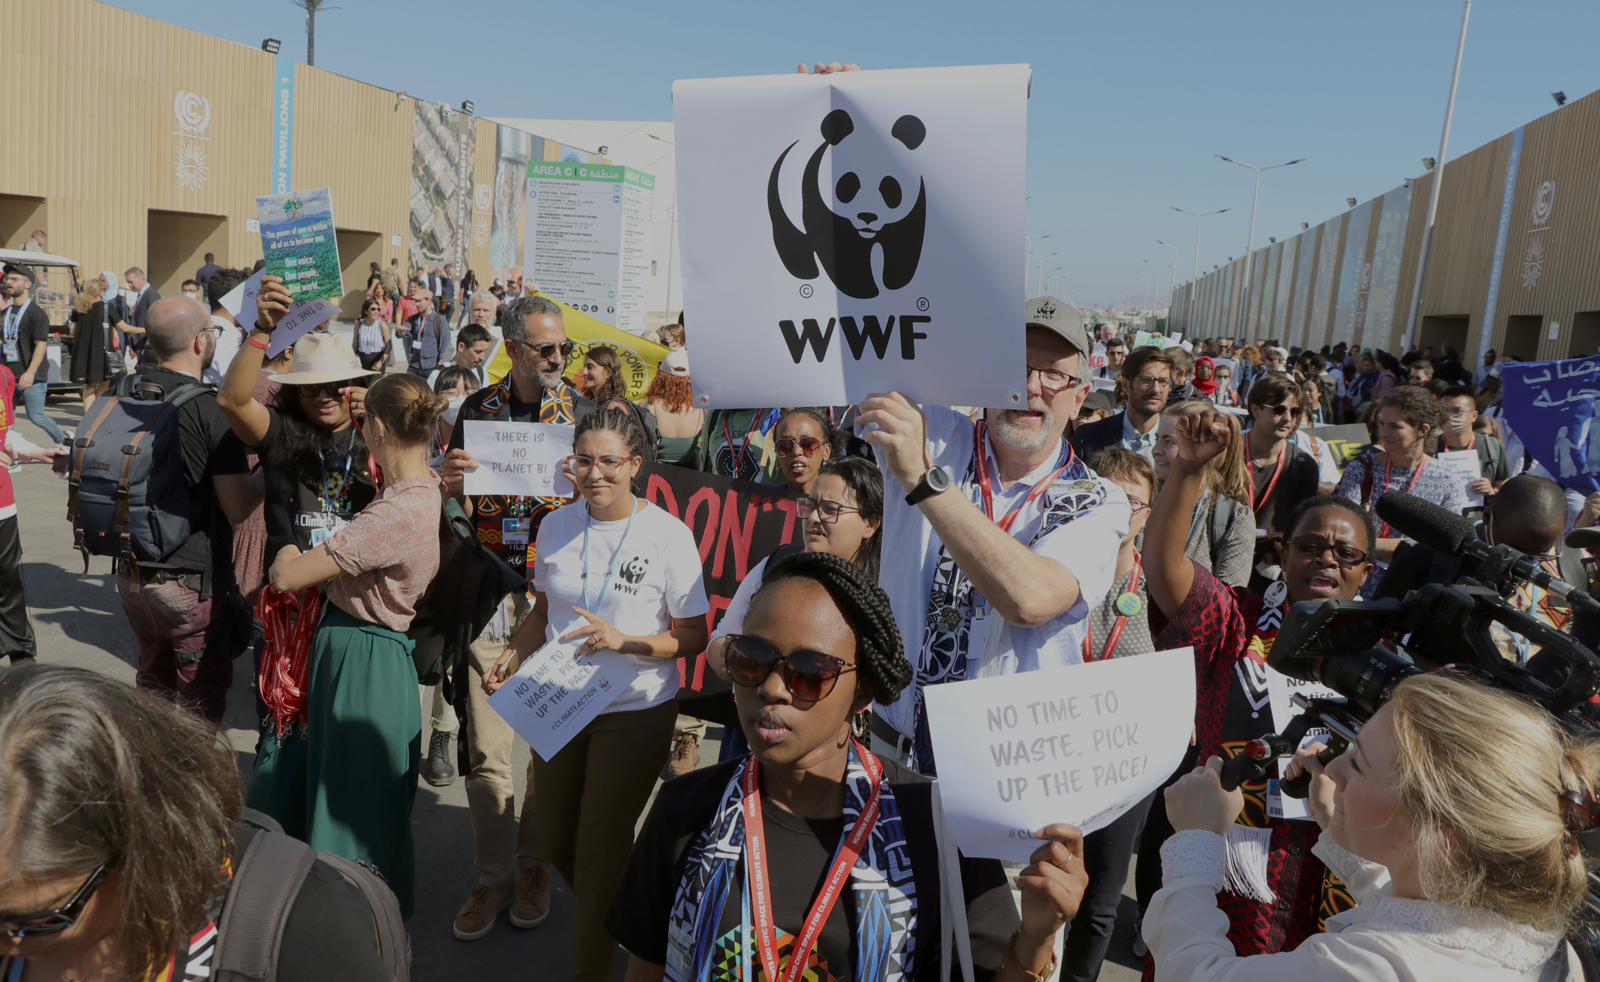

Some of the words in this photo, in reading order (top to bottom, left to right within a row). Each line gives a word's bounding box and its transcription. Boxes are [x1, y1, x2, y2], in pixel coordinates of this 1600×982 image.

[279, 88, 289, 168] PAVILIONS
[532, 165, 562, 176] AREA
[564, 167, 572, 176] C
[579, 168, 587, 177] C
[590, 169, 619, 179] منطقة
[626, 170, 636, 181] AREA
[458, 134, 466, 226] SETTLEMENTS
[1496, 164, 1516, 255] PAVILIONS
[276, 229, 291, 238] power
[455, 228, 464, 276] HUMAN
[285, 258, 297, 267] One
[298, 256, 315, 266] voice,
[285, 272, 297, 280] One
[298, 269, 319, 279] people,
[289, 285, 301, 293] One
[302, 281, 320, 291] world.
[297, 306, 316, 322] TIME
[314, 302, 326, 311] NO
[286, 322, 298, 331] TO
[779, 315, 931, 364] WWF
[495, 432, 529, 442] THERE
[534, 432, 544, 443] IS
[512, 447, 526, 458] NO
[492, 462, 532, 474] PLANET
[537, 463, 547, 474] B!
[300, 514, 334, 527] Climae
[615, 582, 641, 596] WWF
[1369, 657, 1387, 670] 18-80
[514, 682, 529, 698] NO
[528, 662, 550, 685] TIME
[550, 650, 564, 663] TO
[524, 676, 561, 709] WASTE,
[559, 657, 581, 676] PICK
[535, 704, 549, 719] UP
[549, 686, 569, 706] THE
[569, 662, 593, 688] PACE!
[551, 686, 598, 731] #CLIMATEACTION
[986, 704, 1018, 732] NO
[1026, 696, 1081, 725] TIME
[1089, 690, 1118, 715] TO
[990, 734, 1082, 767] WASTE,
[1091, 722, 1139, 750] PICK
[866, 754, 874, 765] AND
[870, 764, 880, 781] CIVIC
[997, 777, 1028, 802] UP
[1036, 769, 1084, 797] THE
[1094, 754, 1148, 788] PACE!
[852, 823, 867, 845] HUMAN
[864, 802, 878, 825] RIGHTS
[752, 836, 760, 860] ACTION
[754, 862, 763, 890] CLIMATE
[759, 905, 767, 927] SPACE
[794, 947, 805, 966] CIVIC
[801, 925, 815, 949] SPACE
[811, 911, 822, 926] FOR
[818, 884, 835, 913] CLIMATE
[831, 861, 847, 886] ACTION
[762, 928, 770, 946] CIVIC
[765, 947, 773, 960] AND
